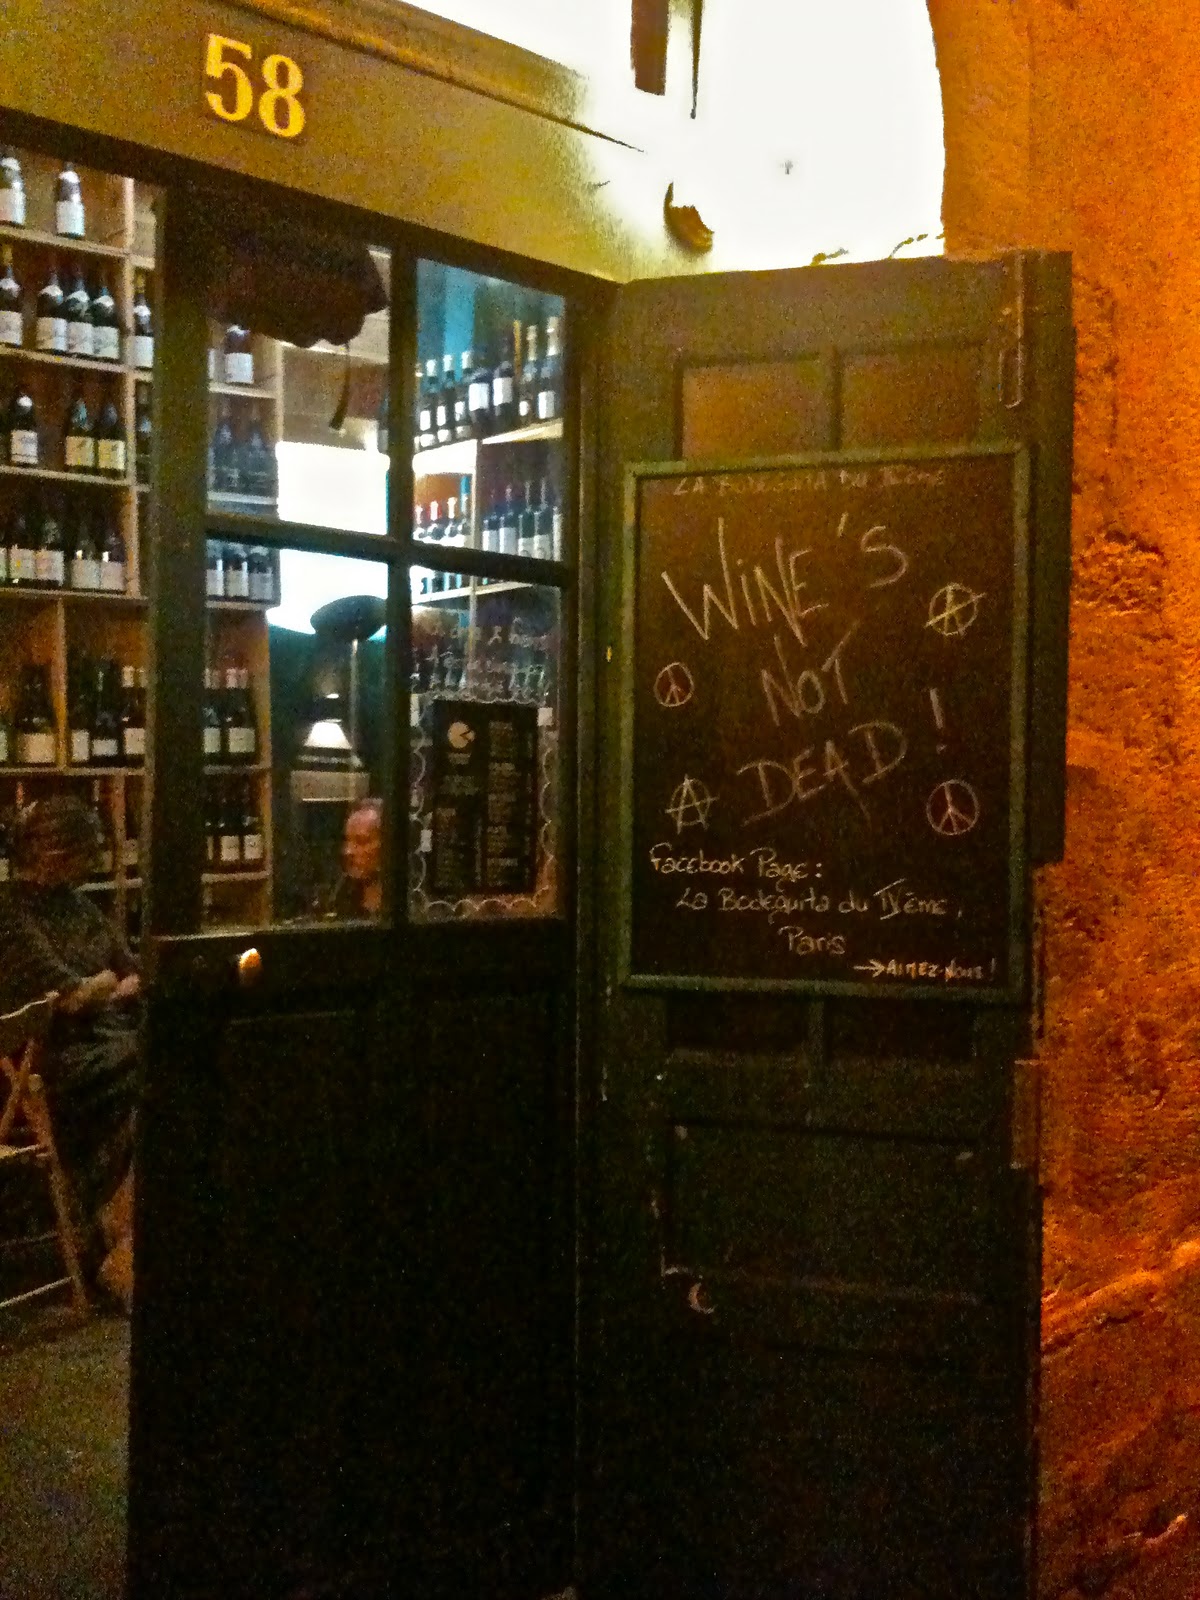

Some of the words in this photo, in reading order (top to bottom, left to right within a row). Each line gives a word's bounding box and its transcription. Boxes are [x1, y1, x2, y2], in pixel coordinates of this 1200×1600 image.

[205, 33, 306, 138] 58
[760, 619, 861, 727] NOT
[736, 719, 908, 828] DEAD
[777, 924, 847, 956] Paris
[837, 890, 868, 914] du
